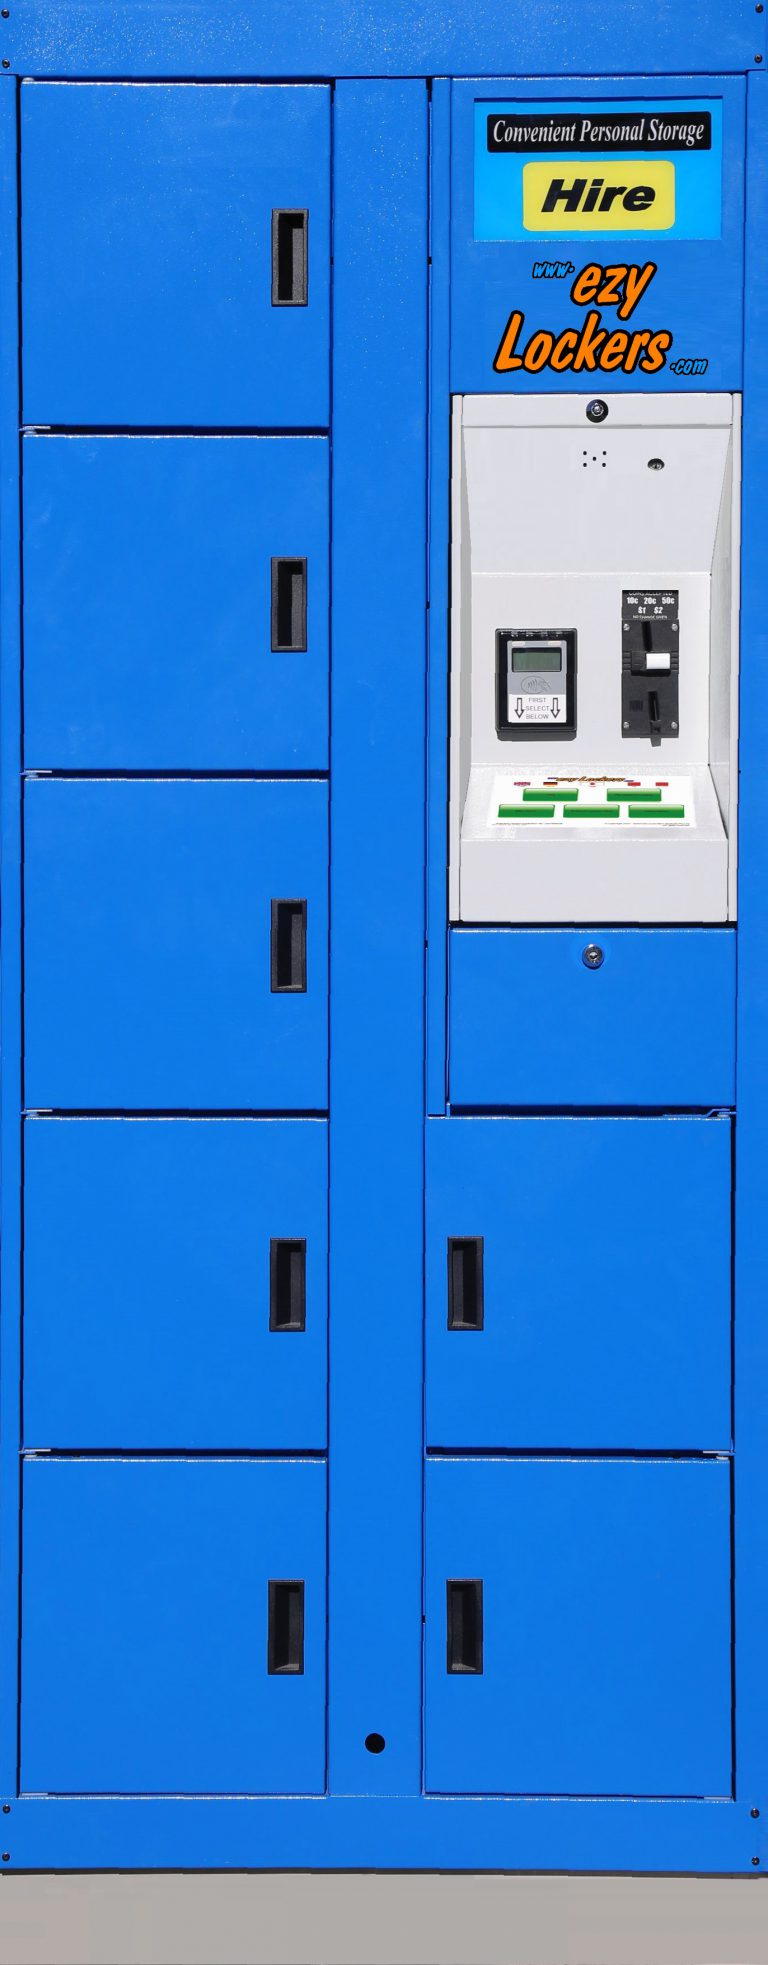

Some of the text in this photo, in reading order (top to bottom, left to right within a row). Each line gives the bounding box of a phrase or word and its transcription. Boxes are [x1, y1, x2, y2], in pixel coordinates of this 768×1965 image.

[493, 119, 704, 146] Convenient Personal Storage
[541, 178, 656, 213] Hire
[570, 261, 658, 321] ezy
[492, 310, 673, 374] Lockers
